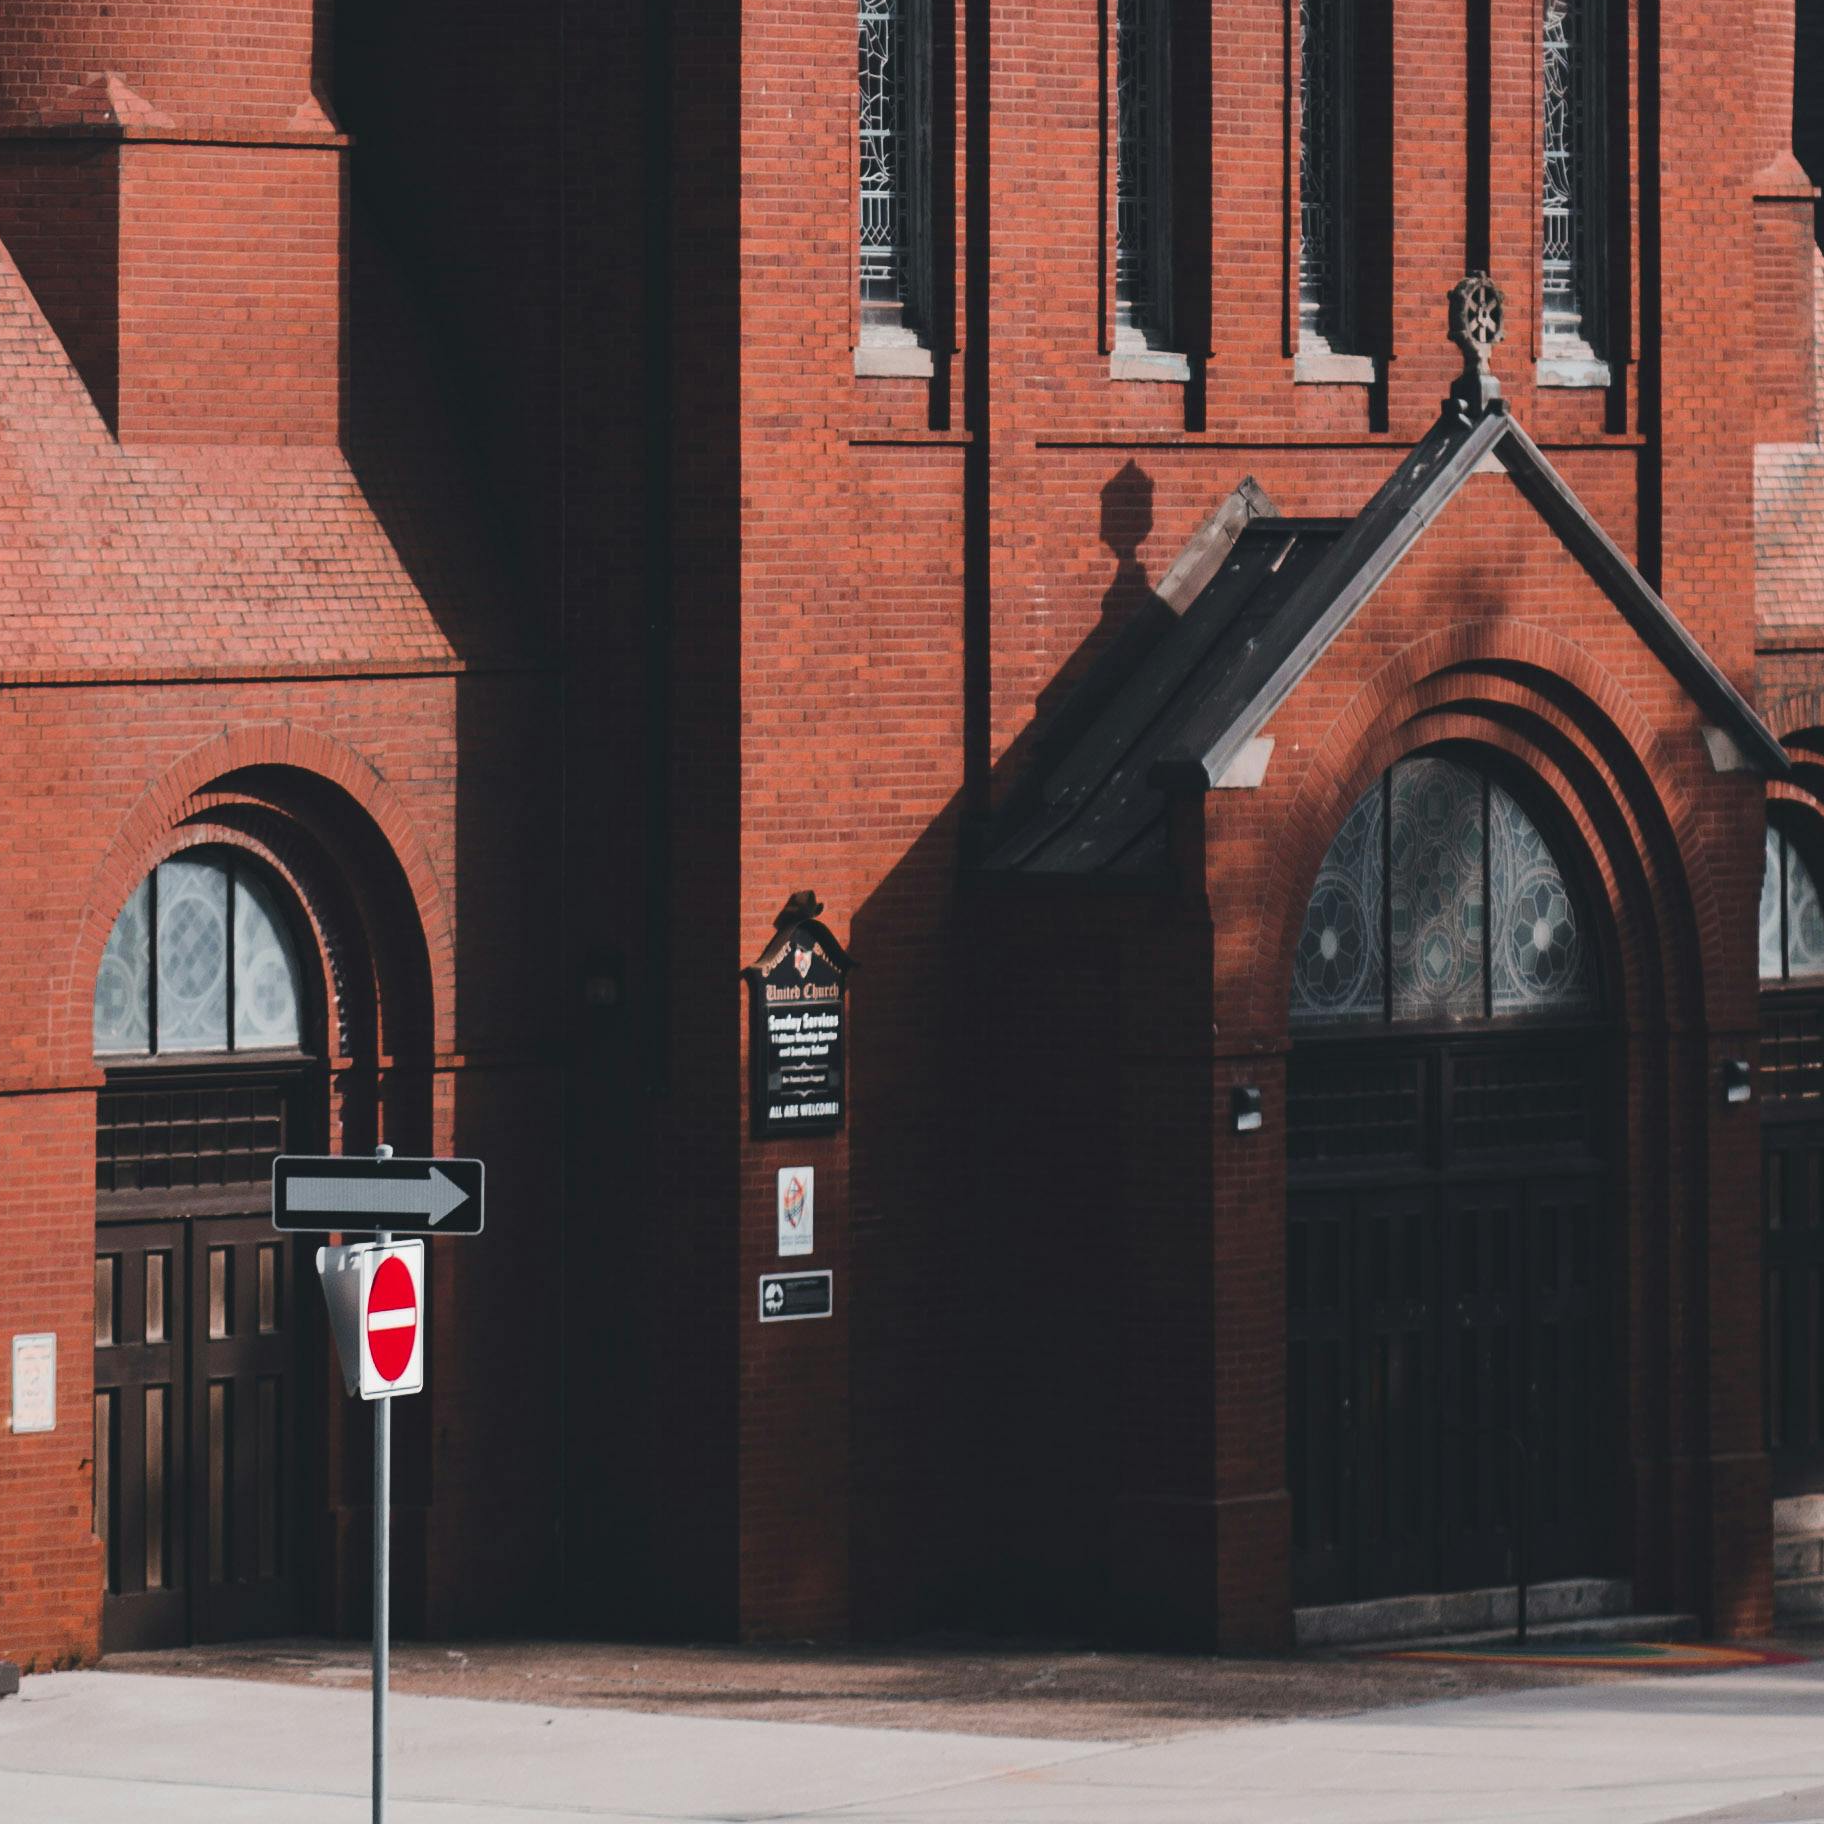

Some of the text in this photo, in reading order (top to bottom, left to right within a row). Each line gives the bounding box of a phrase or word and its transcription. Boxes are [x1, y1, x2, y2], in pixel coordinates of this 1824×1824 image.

[766, 982, 839, 1001] United Church
[768, 1012, 838, 1032] Sunday Services
[769, 1102, 839, 1119] ALL ARE WELCOME!
